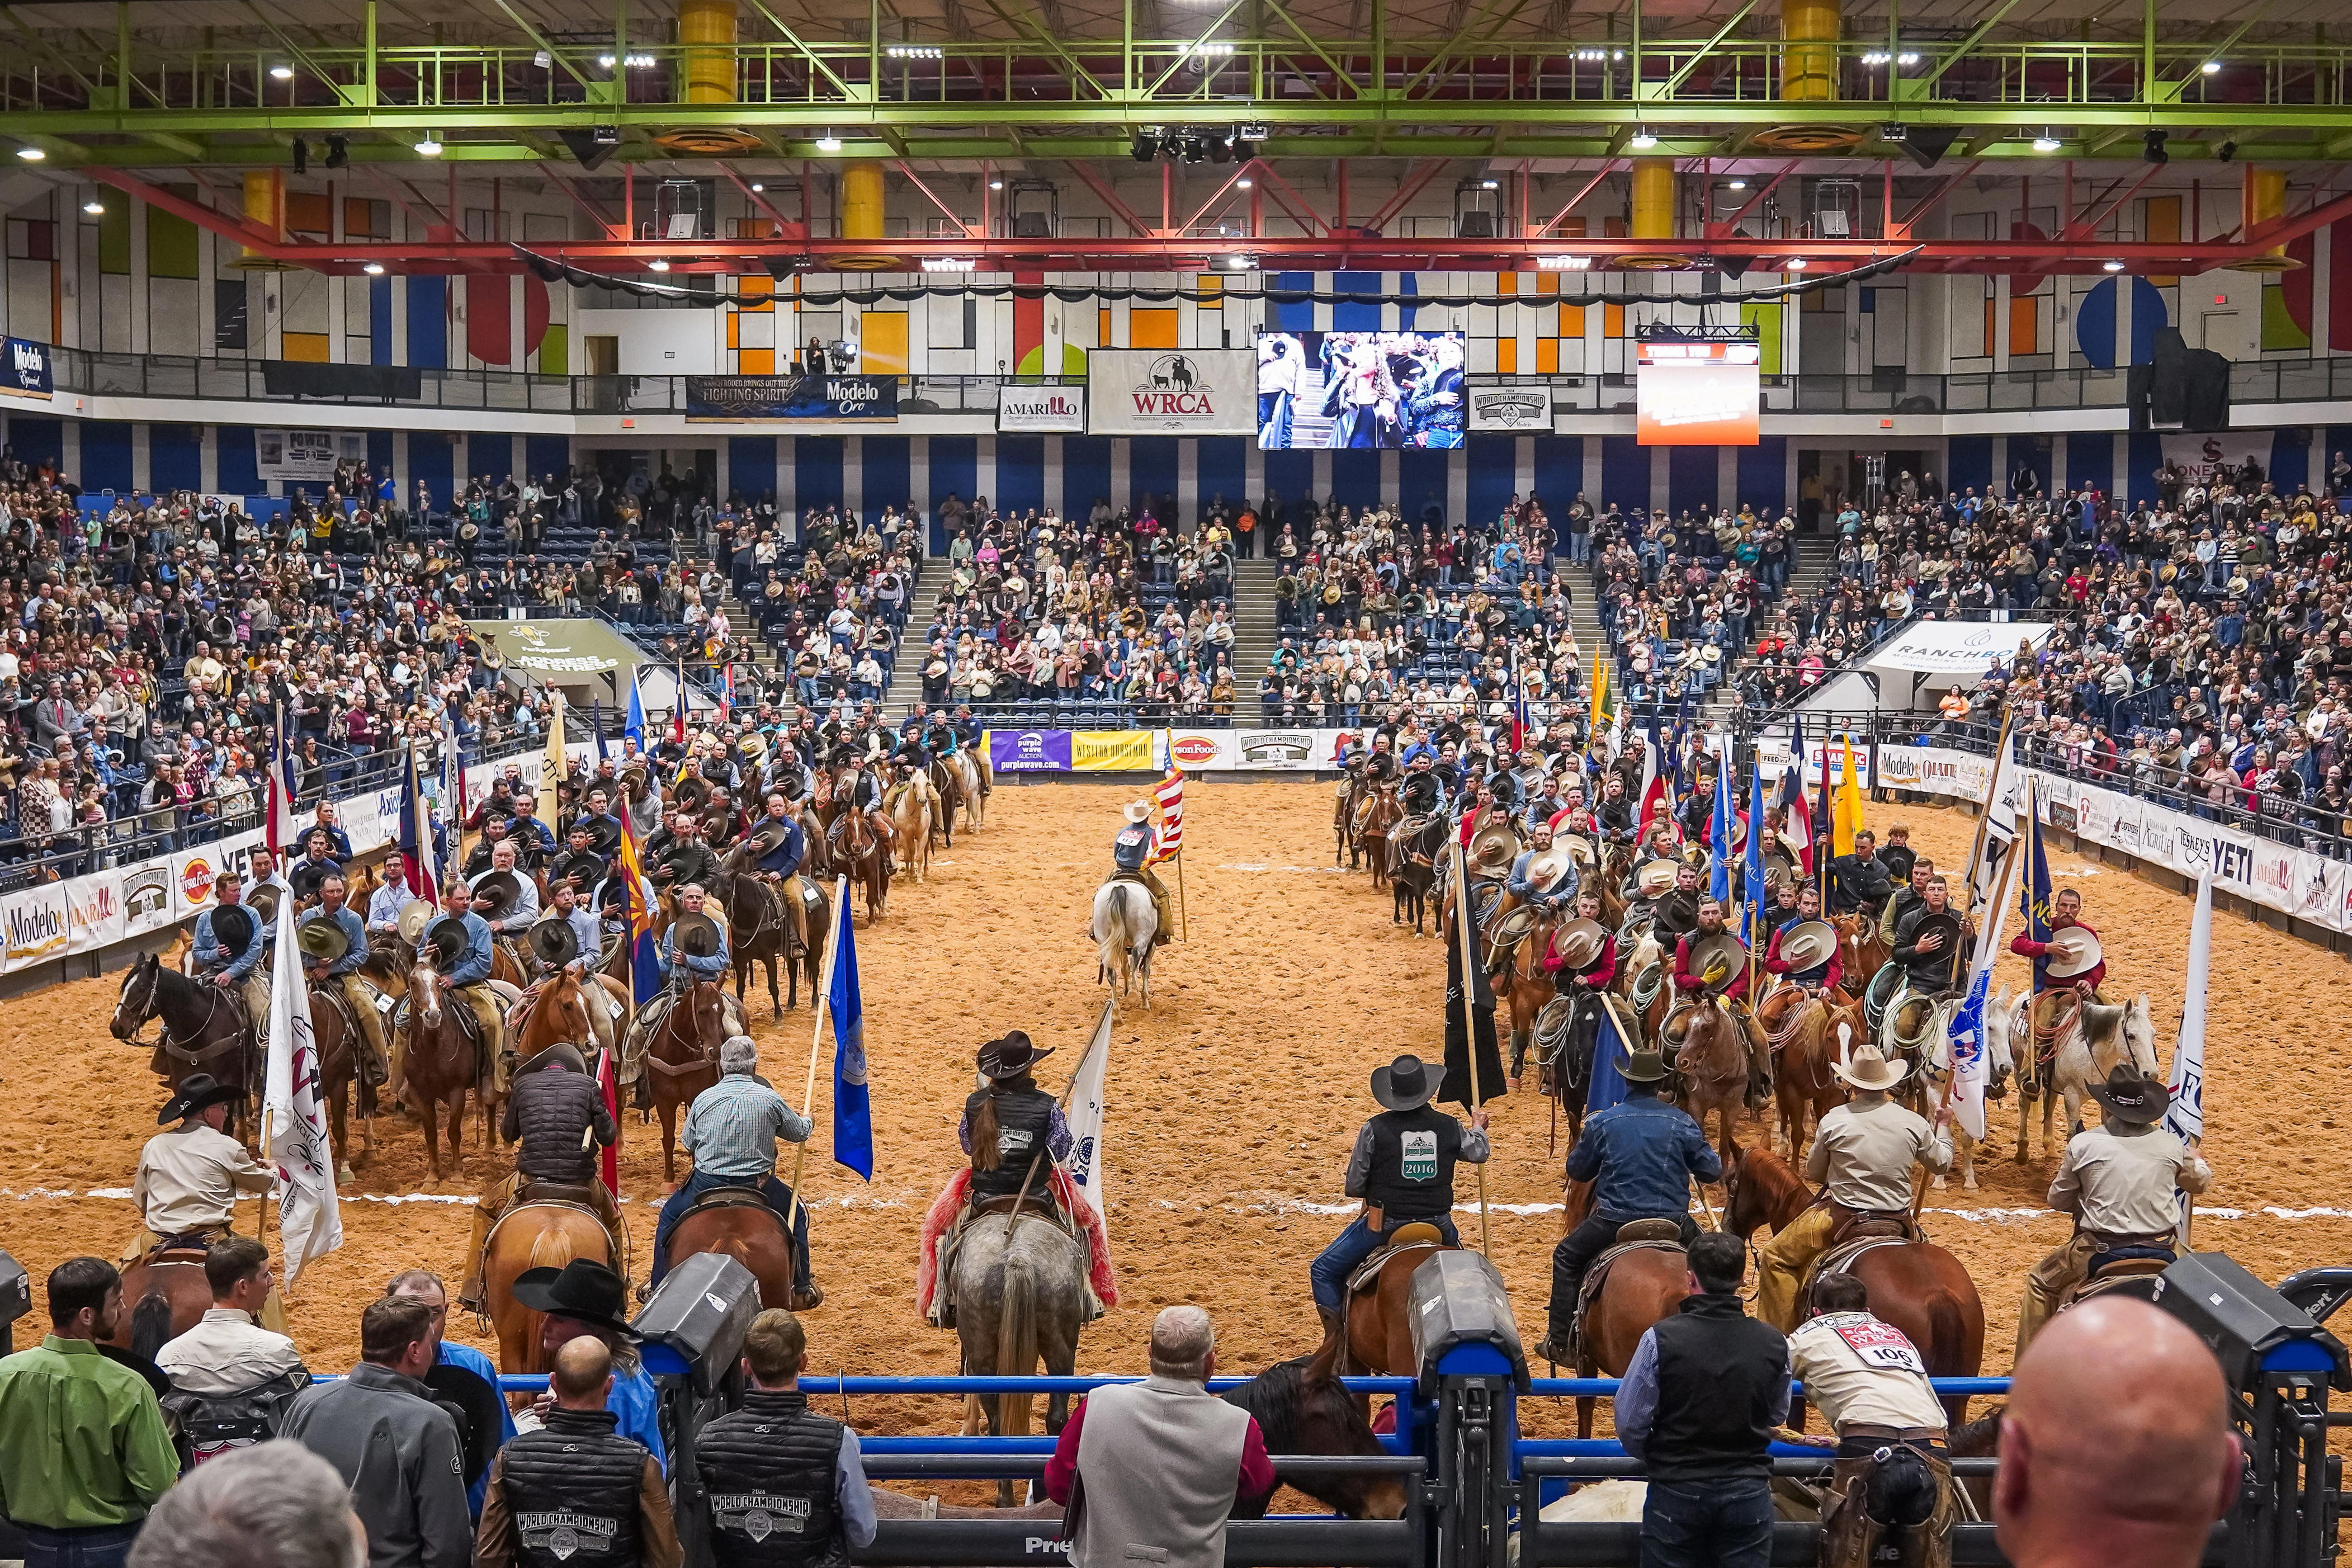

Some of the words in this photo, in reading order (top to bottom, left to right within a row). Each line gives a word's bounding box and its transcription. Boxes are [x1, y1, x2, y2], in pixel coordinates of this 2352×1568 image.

[14, 343, 42, 372] Modelo
[703, 388, 752, 401] FIGHTING
[826, 381, 879, 400] Modelo
[839, 399, 866, 414] Oro
[1004, 396, 1078, 415] AMARILLO
[1132, 393, 1215, 414] WRCA
[1477, 395, 1498, 407] WORLD
[1499, 395, 1544, 407] CHAMPIONSHIP
[290, 433, 331, 448] POWER
[1898, 645, 2013, 658] RANCHBO
[520, 655, 600, 665] ADDRESS
[551, 658, 619, 672] STRESS
[1018, 739, 1042, 748] purple
[1243, 738, 1264, 749] WORLD
[1265, 736, 1311, 748] CHAMPIONSHIP
[1001, 760, 1060, 770] purplewave.com
[1883, 752, 1914, 776] Modelo
[2176, 826, 2209, 862] TESKEY'S
[222, 842, 264, 885] YE
[2212, 837, 2252, 885] YETI
[2306, 889, 2330, 914] WRCA
[10, 901, 58, 947] Modelo
[1405, 1164, 1434, 1174] 2016
[1849, 1334, 1903, 1344] WRCA
[1873, 1348, 1912, 1364] 106
[711, 1495, 743, 1511] WORLD
[743, 1495, 810, 1517] CHAMPIONSHIP
[517, 1513, 548, 1531] WORLD
[548, 1513, 617, 1536] CHAMPIONSHIP
